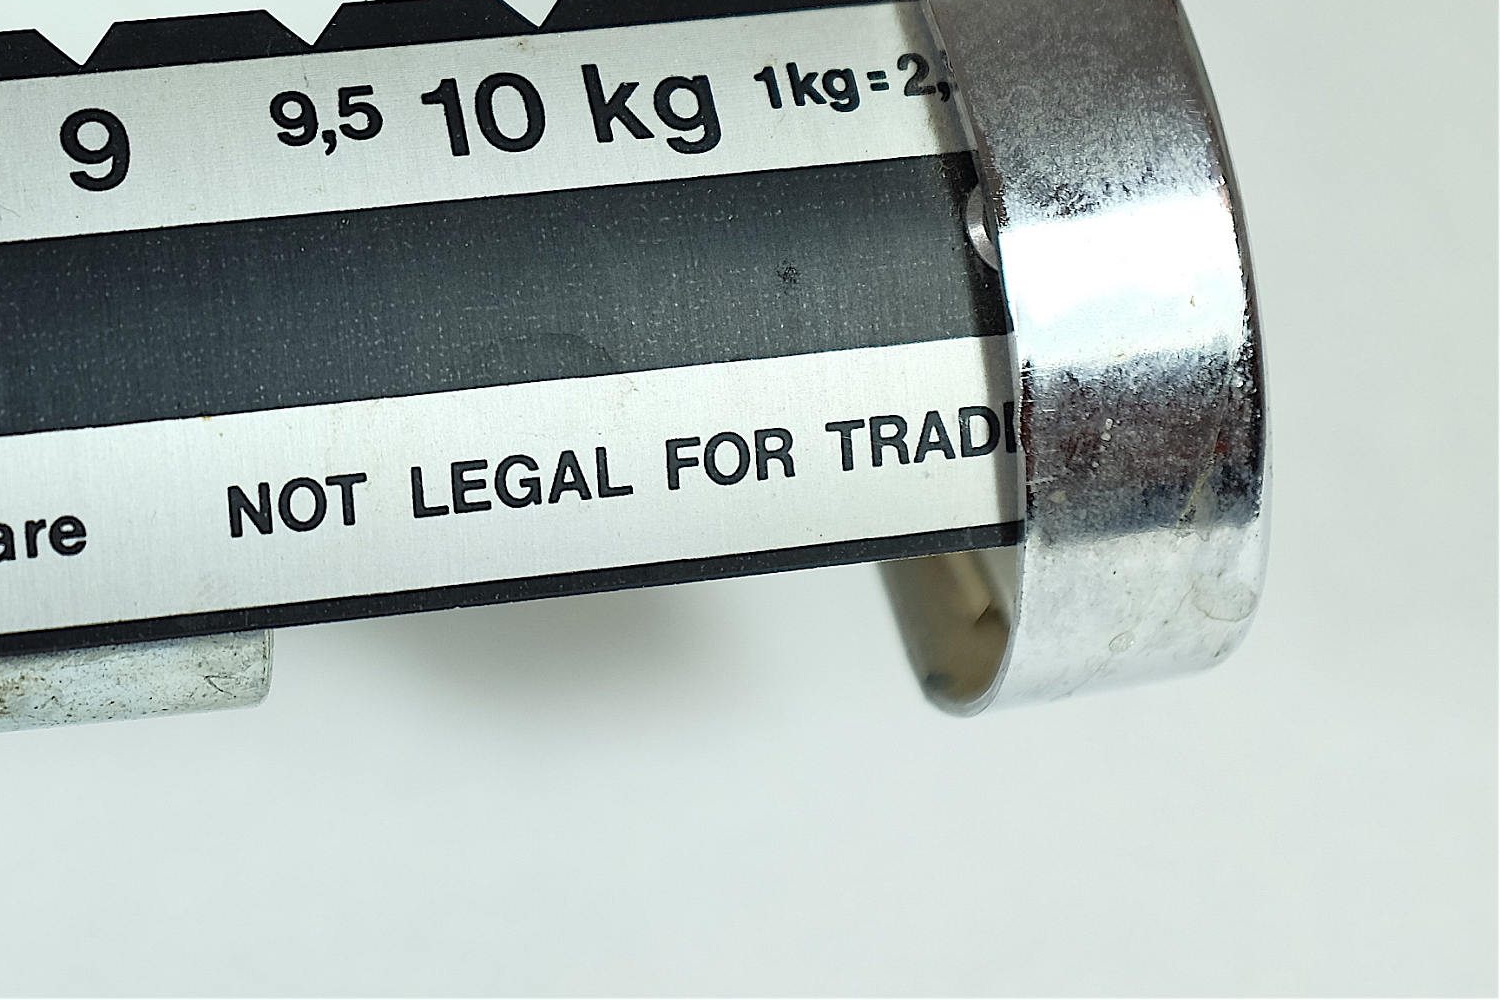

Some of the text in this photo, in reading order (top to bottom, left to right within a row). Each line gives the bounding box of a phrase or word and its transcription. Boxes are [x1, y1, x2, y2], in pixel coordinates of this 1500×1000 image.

[59, 107, 131, 192] 9
[269, 84, 384, 156] 9,5
[420, 71, 546, 157] 10
[580, 63, 722, 155] kg
[226, 472, 368, 539] NOT
[410, 446, 634, 519] LEGAL
[665, 427, 796, 491] FOR
